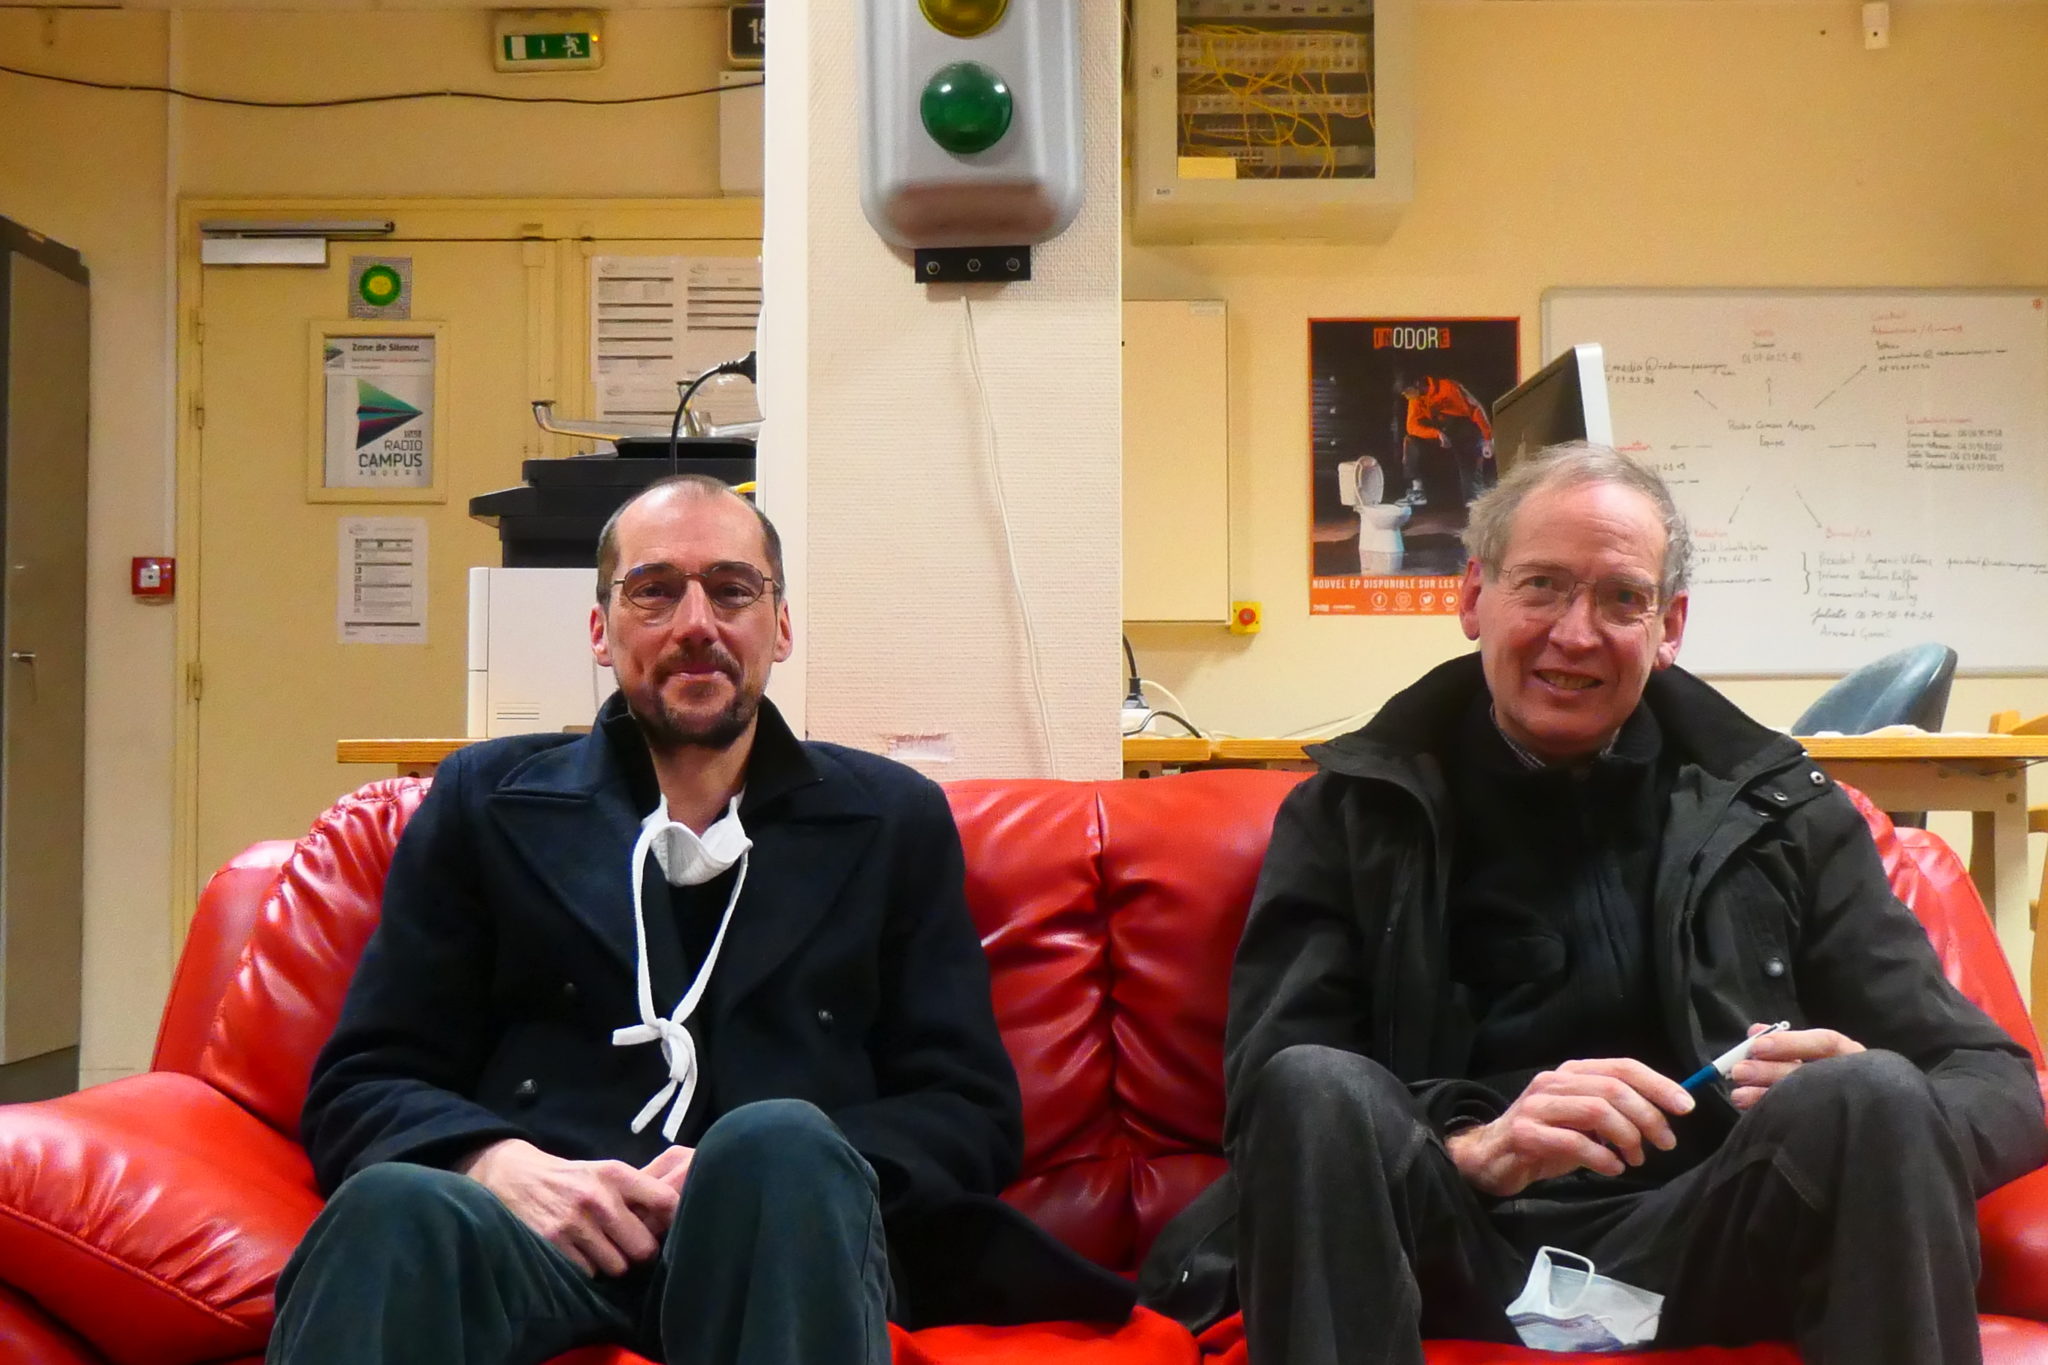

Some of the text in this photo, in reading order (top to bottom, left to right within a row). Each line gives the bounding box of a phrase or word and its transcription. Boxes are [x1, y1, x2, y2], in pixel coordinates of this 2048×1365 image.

[352, 343, 419, 352] Zone de Silence
[384, 440, 423, 452] RADIO
[358, 453, 423, 468] CAMPUS
[1312, 579, 1347, 589] NOUVEL
[1350, 579, 1361, 589] EP
[1363, 578, 1416, 589] DISPONIBLE
[1418, 578, 1436, 589] SUR
[1438, 578, 1455, 589] LES
